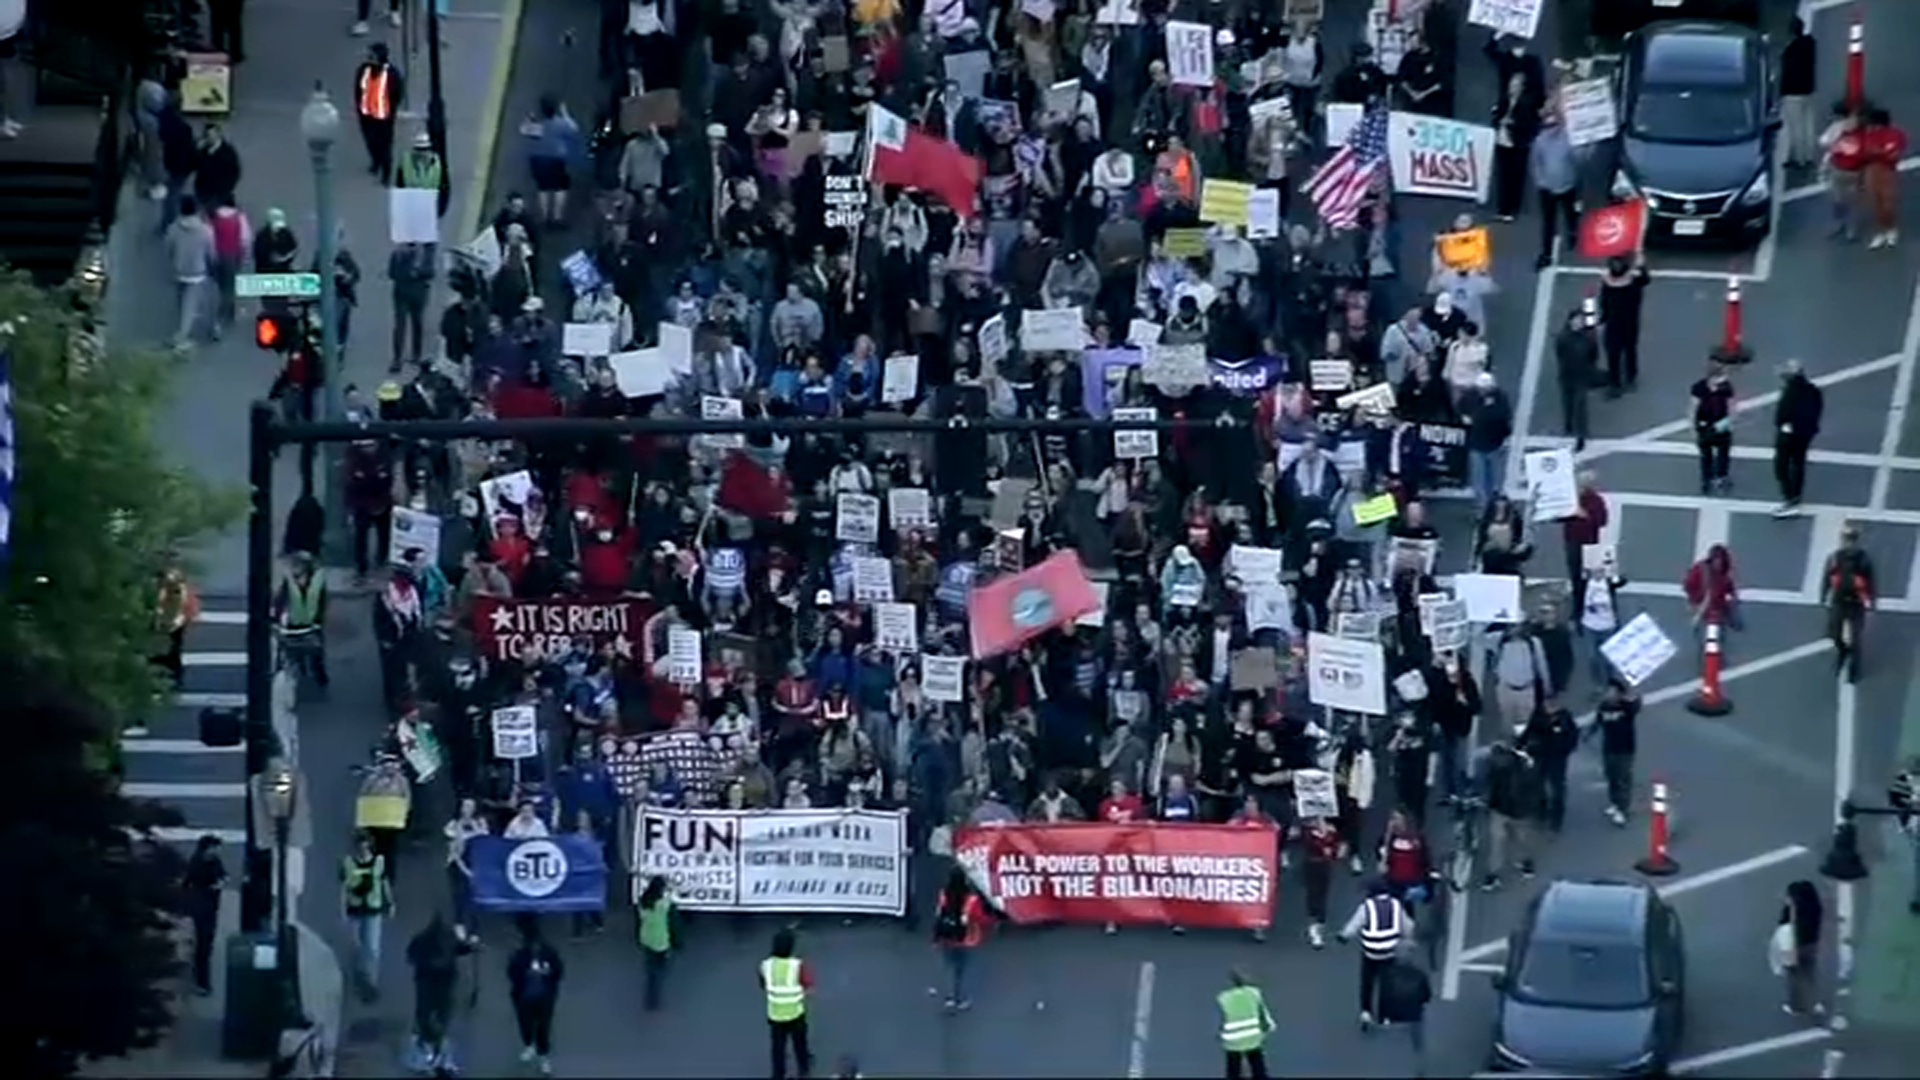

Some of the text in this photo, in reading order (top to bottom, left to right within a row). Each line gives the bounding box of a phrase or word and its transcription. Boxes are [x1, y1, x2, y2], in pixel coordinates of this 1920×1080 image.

[1414, 121, 1466, 154] 350
[1411, 151, 1468, 184] MASS
[824, 210, 865, 228] SHIP
[1213, 367, 1267, 389] nited
[517, 602, 630, 633] IT IS RIGHT
[645, 817, 734, 852] FUN
[513, 851, 559, 880] BTU
[643, 852, 734, 868] FEDERAL
[794, 851, 813, 867] FOR
[997, 854, 1031, 872] ALL
[1034, 854, 1101, 873] POWER
[1103, 854, 1130, 873] TO
[1132, 855, 1169, 873] THE
[1170, 856, 1269, 879] WORKERS,
[1000, 875, 1269, 903] NOT THE BILLIONAIRES!
